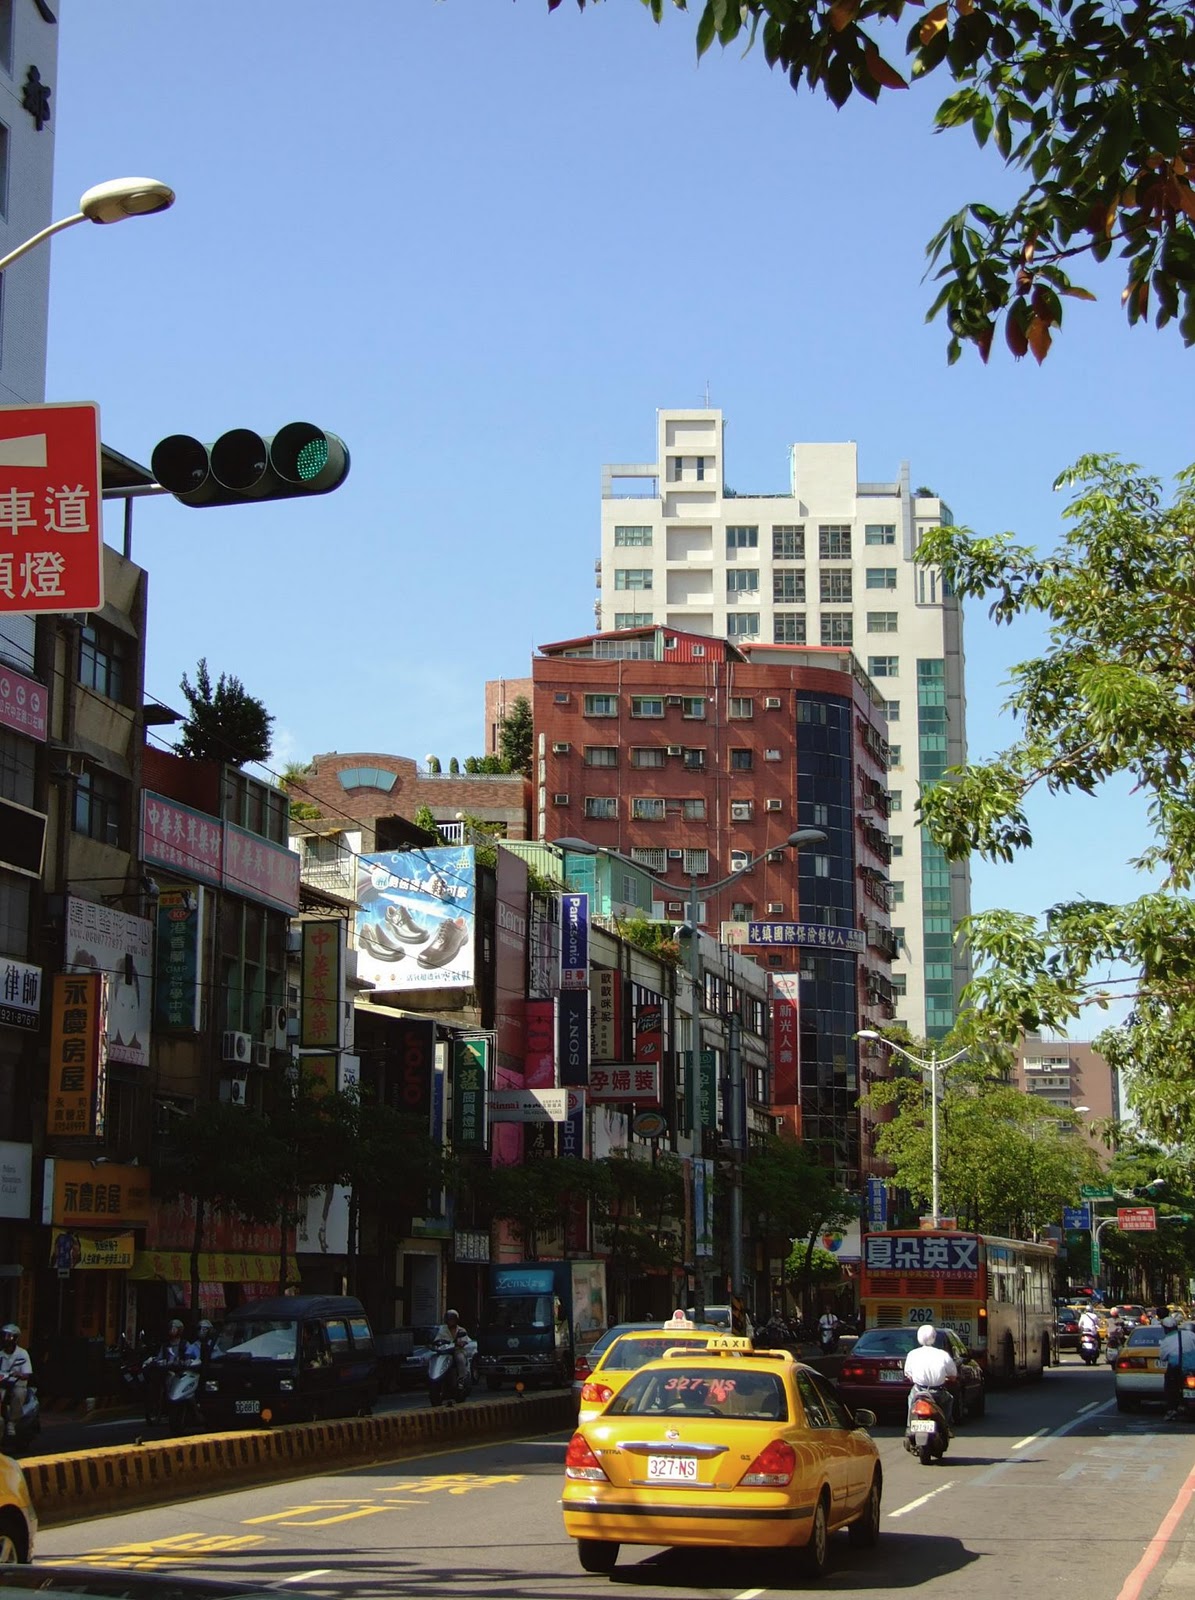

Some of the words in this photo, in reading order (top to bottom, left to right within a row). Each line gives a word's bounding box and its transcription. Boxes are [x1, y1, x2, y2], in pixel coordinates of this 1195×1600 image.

[0, 484, 91, 535] 車道
[569, 897, 581, 965] Panasonic
[5, 964, 38, 1005] 律師
[60, 979, 88, 1092] 永慶房屋
[569, 1010, 580, 1066] SONY
[779, 1004, 793, 1063] 新光人壽
[590, 1070, 654, 1091] 孕婦裝
[64, 1182, 121, 1213] 永慶房屋
[867, 1237, 977, 1270] 夏朵英文
[910, 1308, 933, 1322] 262
[713, 1339, 746, 1348] TAXI
[664, 1377, 736, 1392] 327-NS
